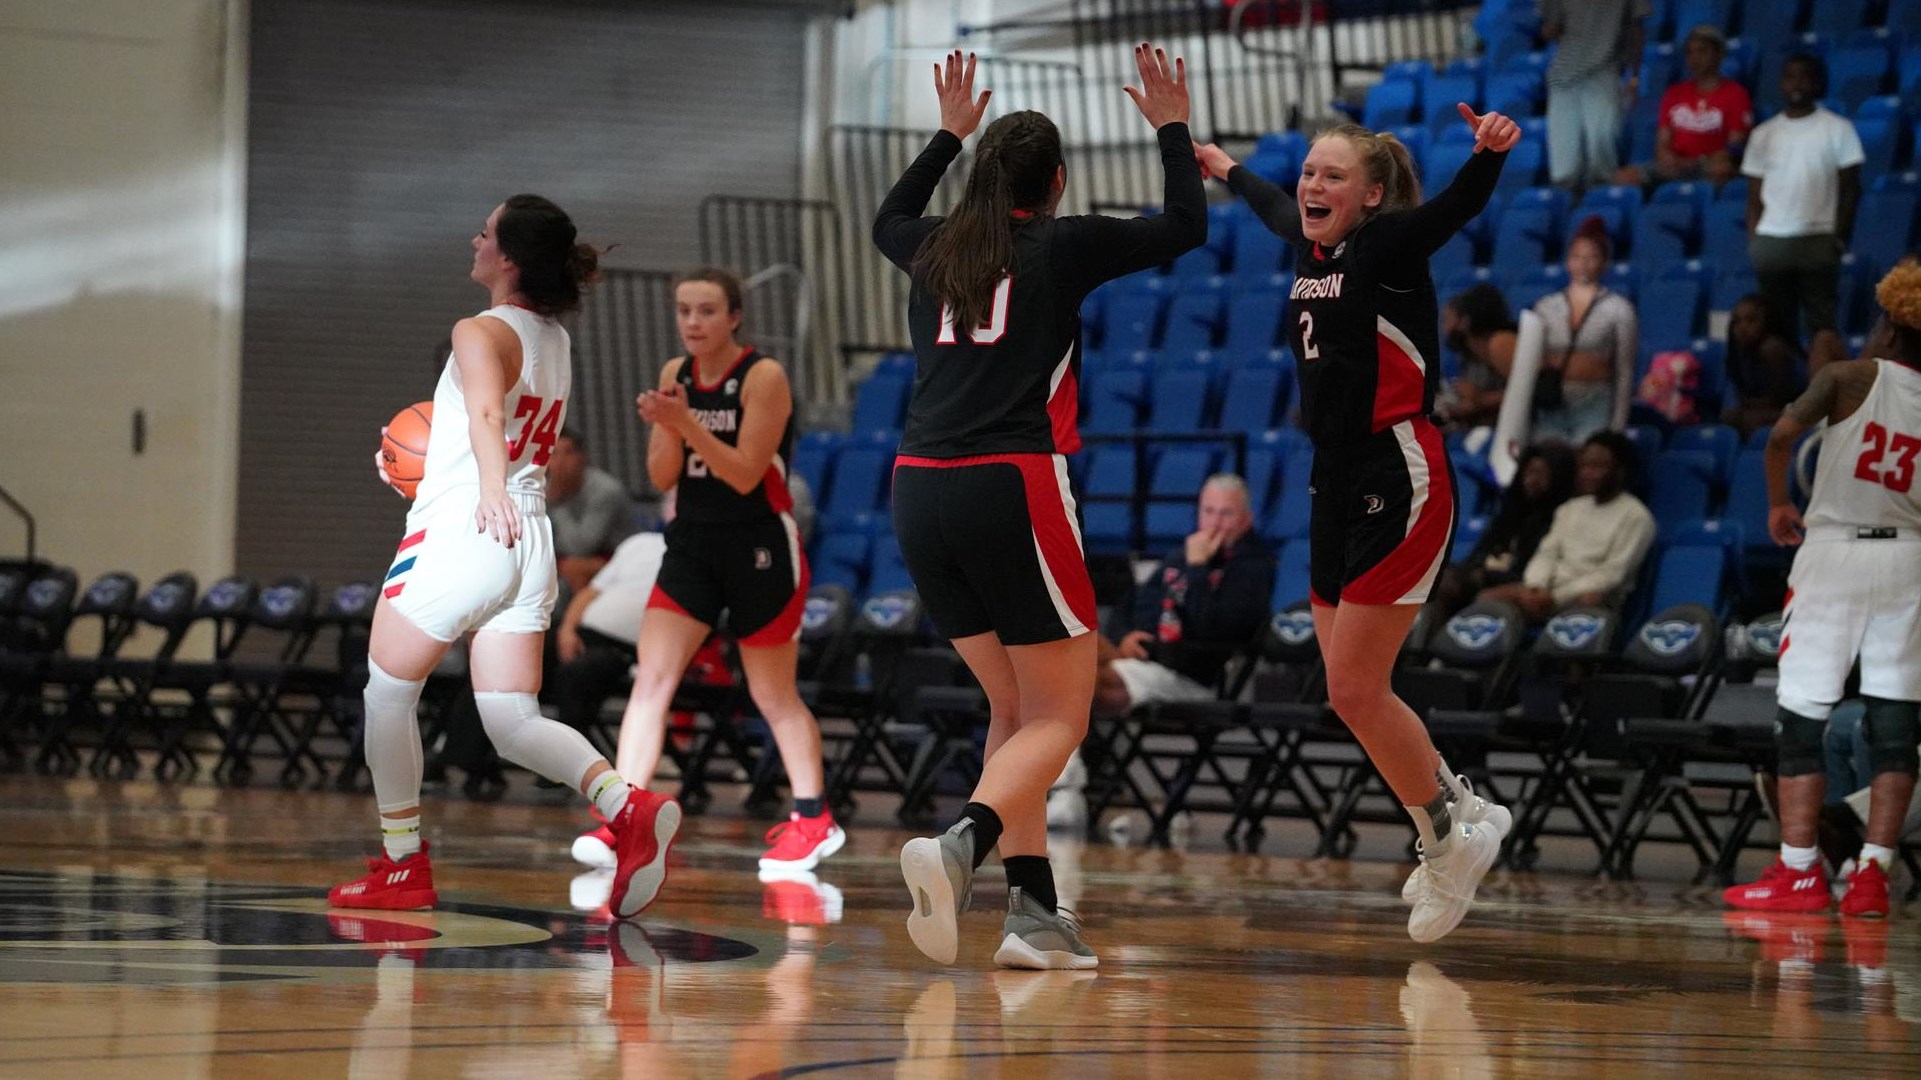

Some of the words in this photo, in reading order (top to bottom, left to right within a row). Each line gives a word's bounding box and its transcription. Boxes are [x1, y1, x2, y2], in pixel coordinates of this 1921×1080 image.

[1299, 311, 1320, 360] 2
[507, 394, 563, 467] 34
[1854, 420, 1921, 494] 23
